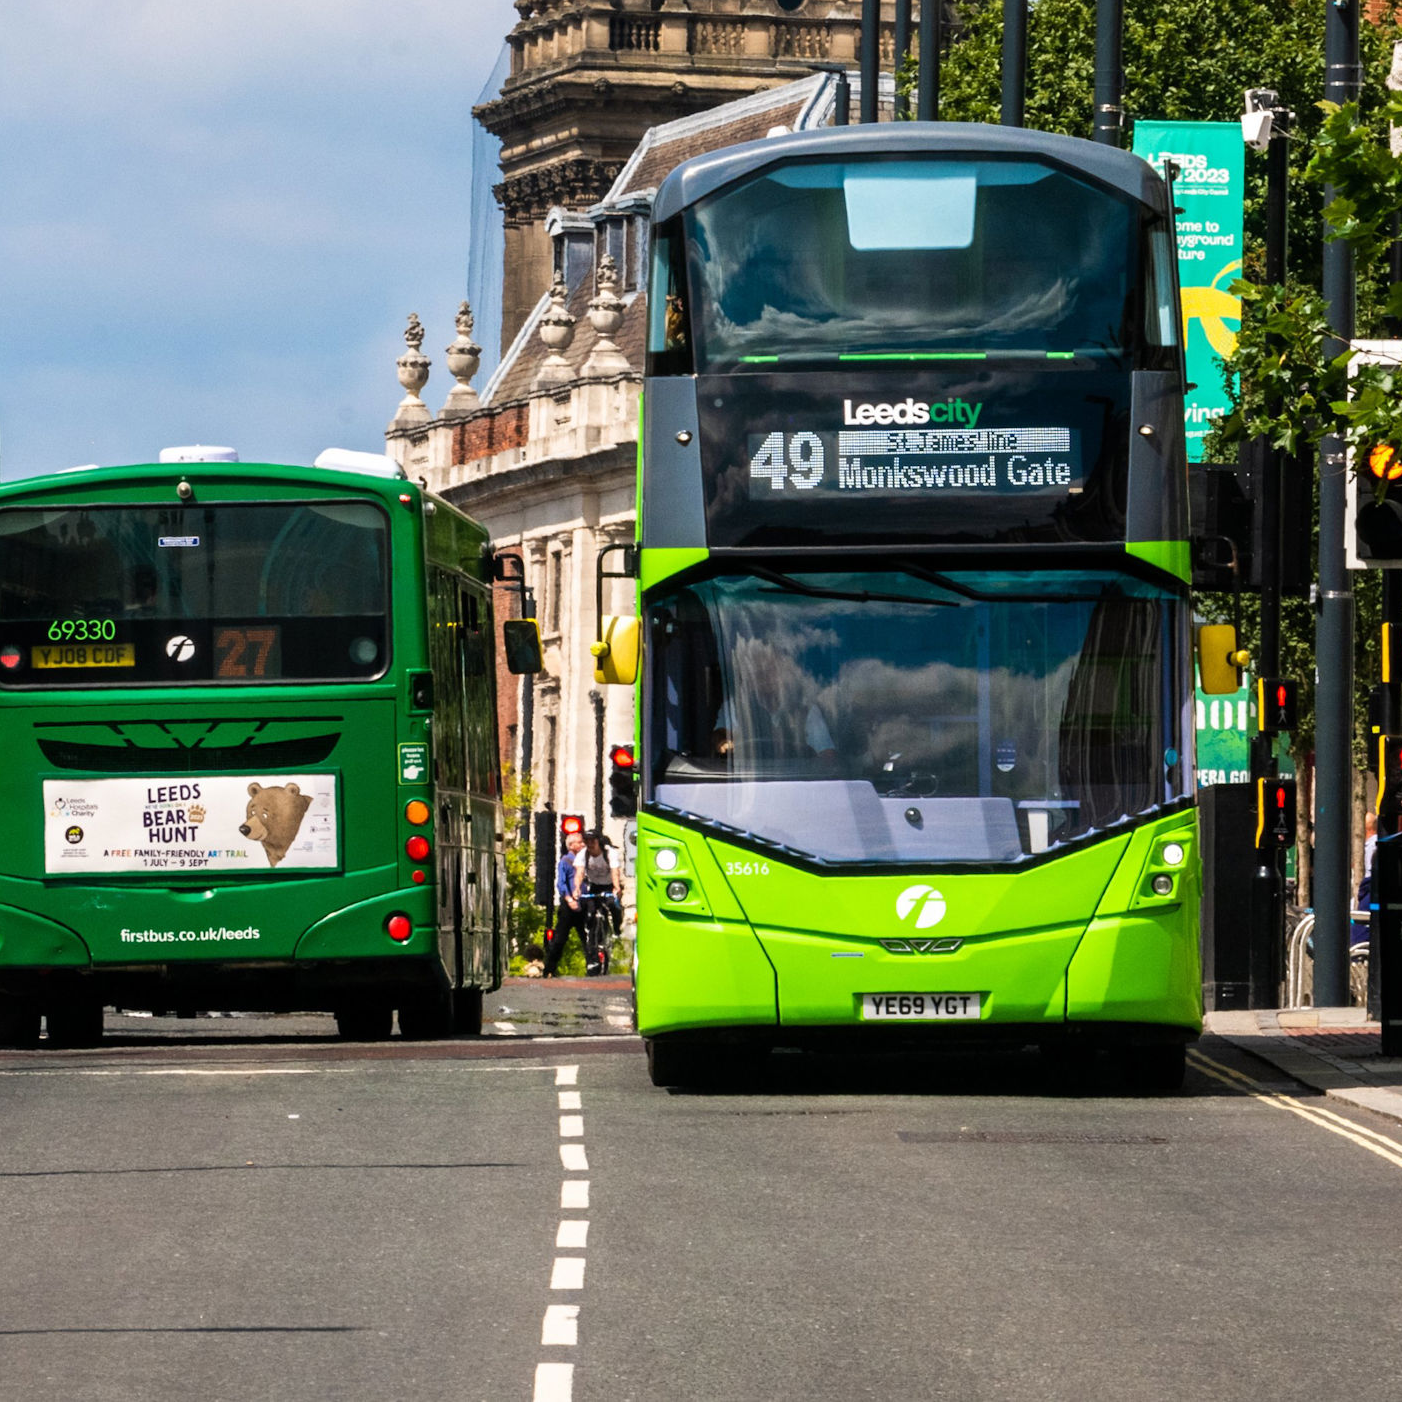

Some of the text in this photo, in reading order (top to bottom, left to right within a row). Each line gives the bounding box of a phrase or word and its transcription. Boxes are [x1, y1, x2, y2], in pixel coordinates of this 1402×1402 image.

[1184, 168, 1230, 184] 2023
[1204, 220, 1220, 233] to
[1176, 234, 1234, 248] yground
[1178, 250, 1206, 261] ture
[844, 397, 982, 429] Leedscity
[750, 431, 824, 490] 49
[838, 455, 1071, 488] Monkswood Gate
[48, 619, 116, 642] 69330
[42, 646, 126, 666] YJ08 CDF
[216, 629, 276, 676] 27
[147, 783, 202, 804] LEEDS
[71, 810, 95, 818] Charity
[142, 809, 186, 828] BEAR
[149, 826, 198, 844] HUNT
[104, 849, 249, 858] A FREE FAMILY-FRIENDLY ART TRAIL
[143, 858, 208, 867] 1 JULY 9 SEPT
[726, 862, 770, 876] 35616
[120, 926, 260, 942] firstbus.co.uk/leeds
[872, 996, 970, 1016] YE69 YGT
